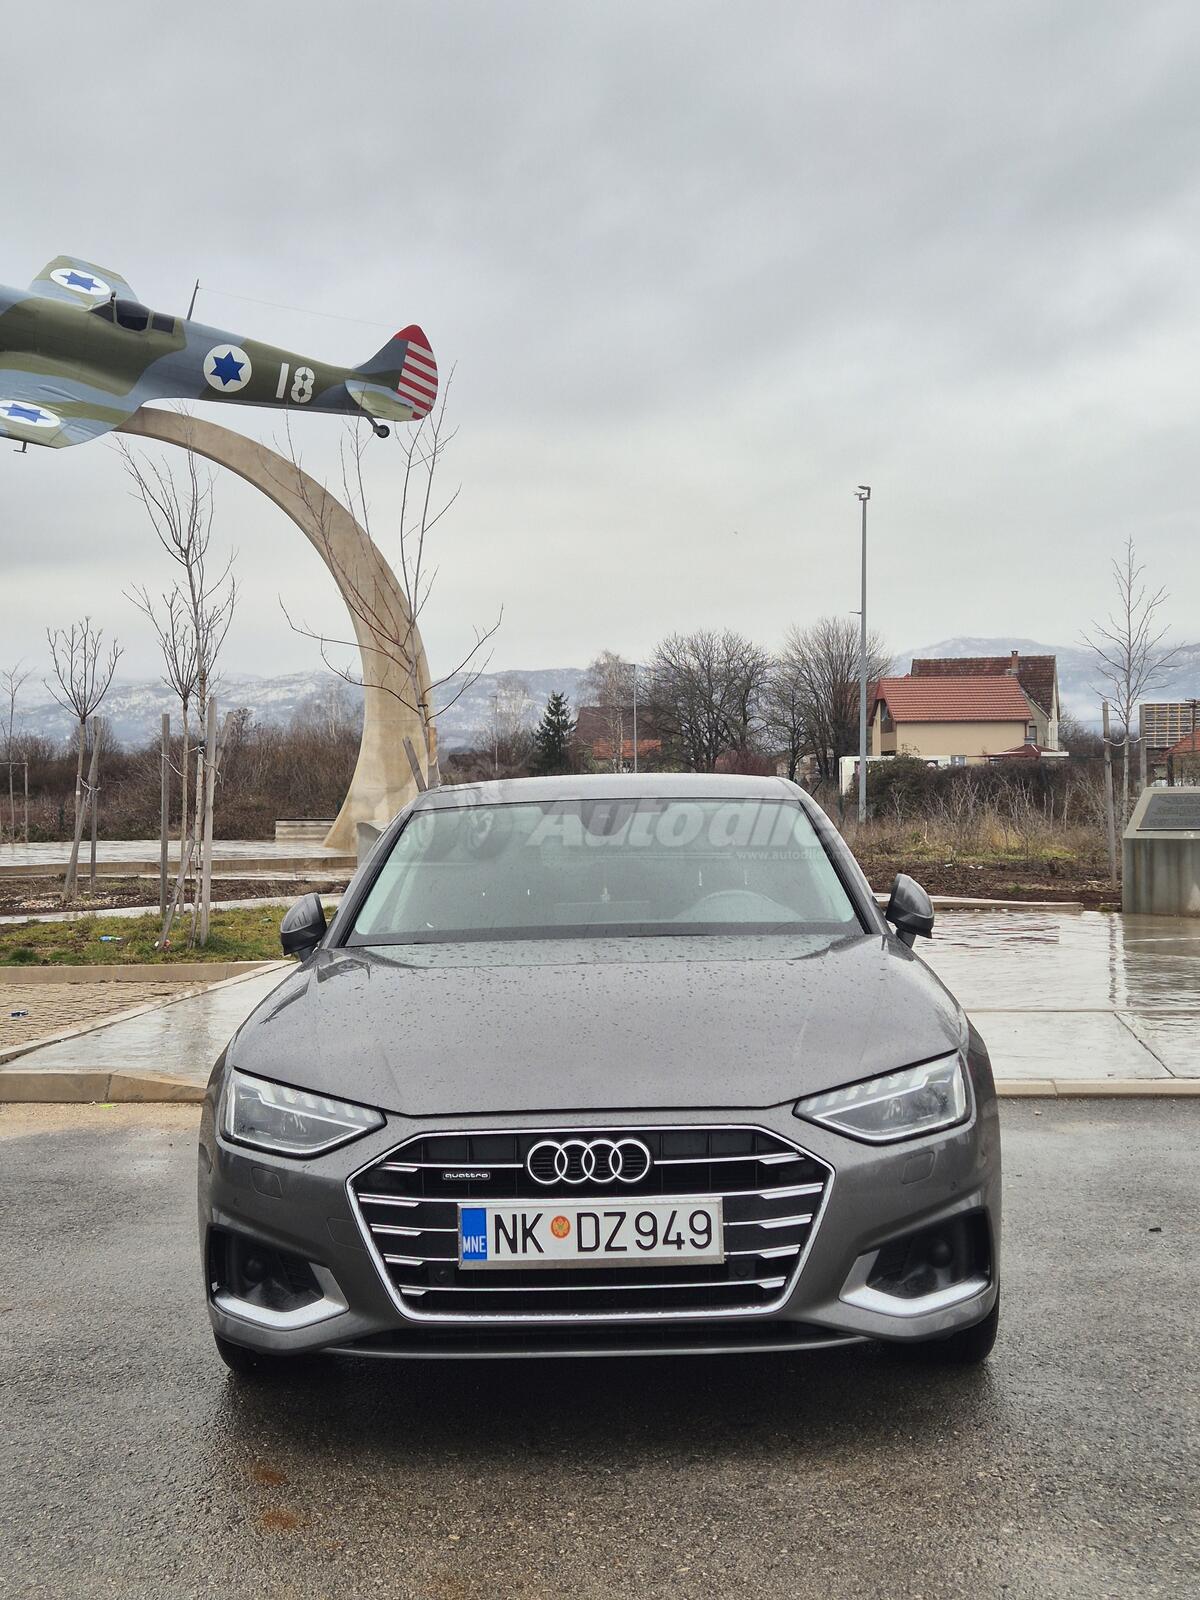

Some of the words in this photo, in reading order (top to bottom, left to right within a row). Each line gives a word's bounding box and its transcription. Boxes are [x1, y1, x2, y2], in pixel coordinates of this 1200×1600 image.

[275, 362, 315, 404] 18
[462, 1235, 487, 1254] MNE
[494, 1212, 545, 1255] NK
[576, 1209, 713, 1252] DZ949
